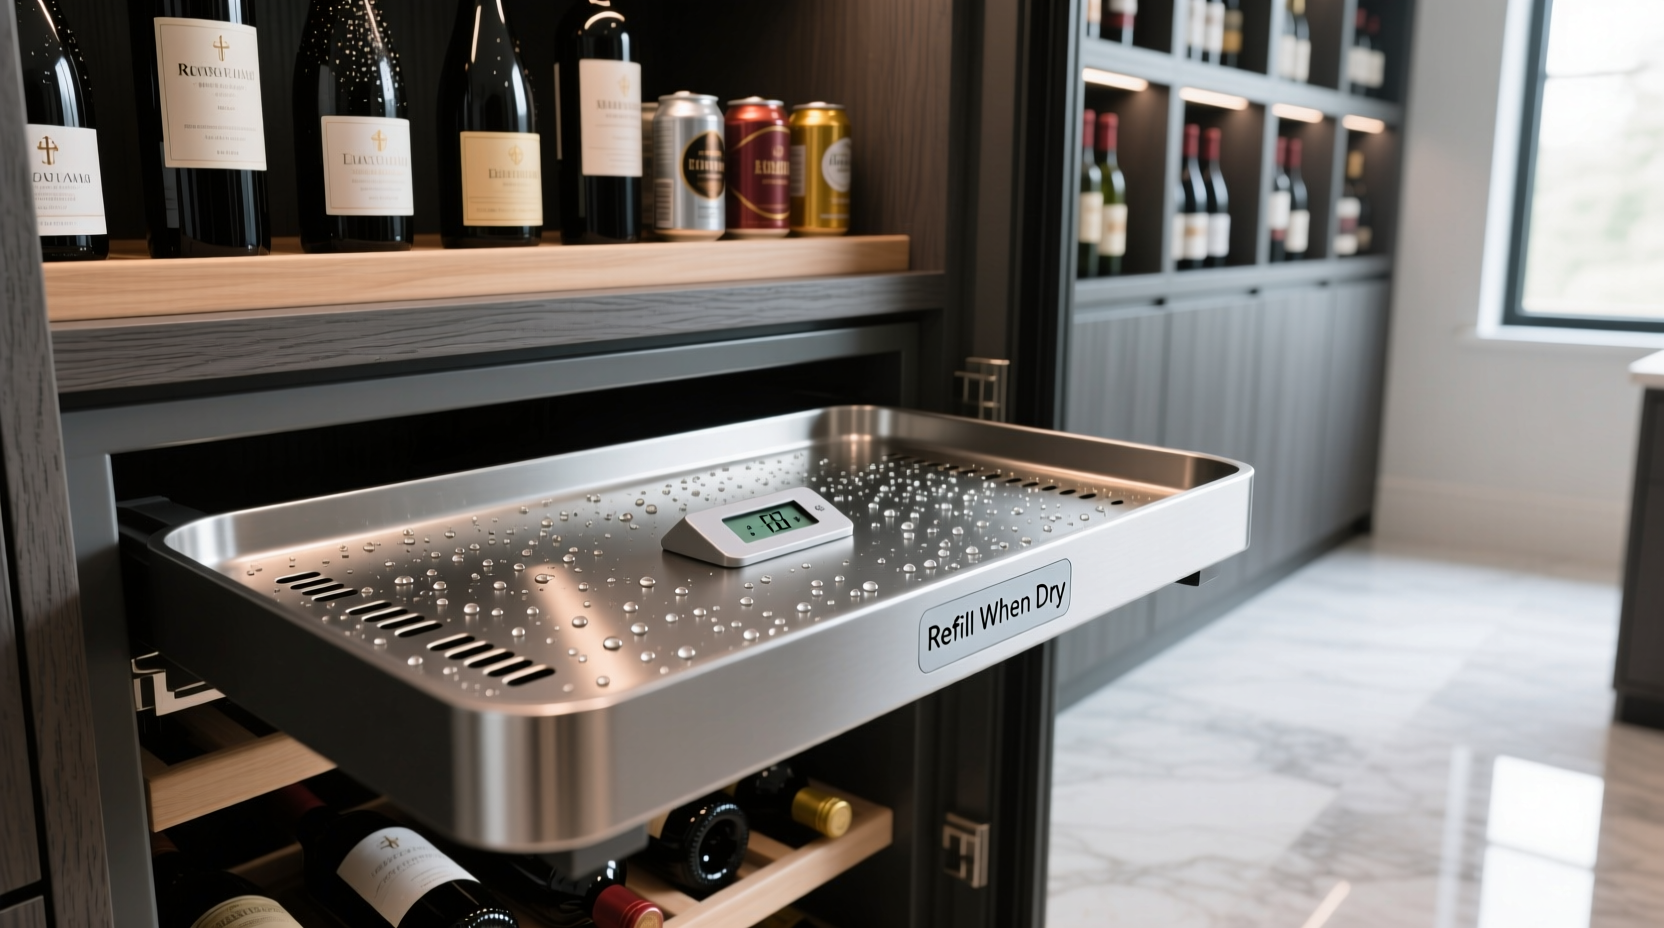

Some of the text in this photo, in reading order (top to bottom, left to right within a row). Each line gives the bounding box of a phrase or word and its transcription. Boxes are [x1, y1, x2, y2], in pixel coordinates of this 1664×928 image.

[928, 582, 1066, 651] Refill When Dry
